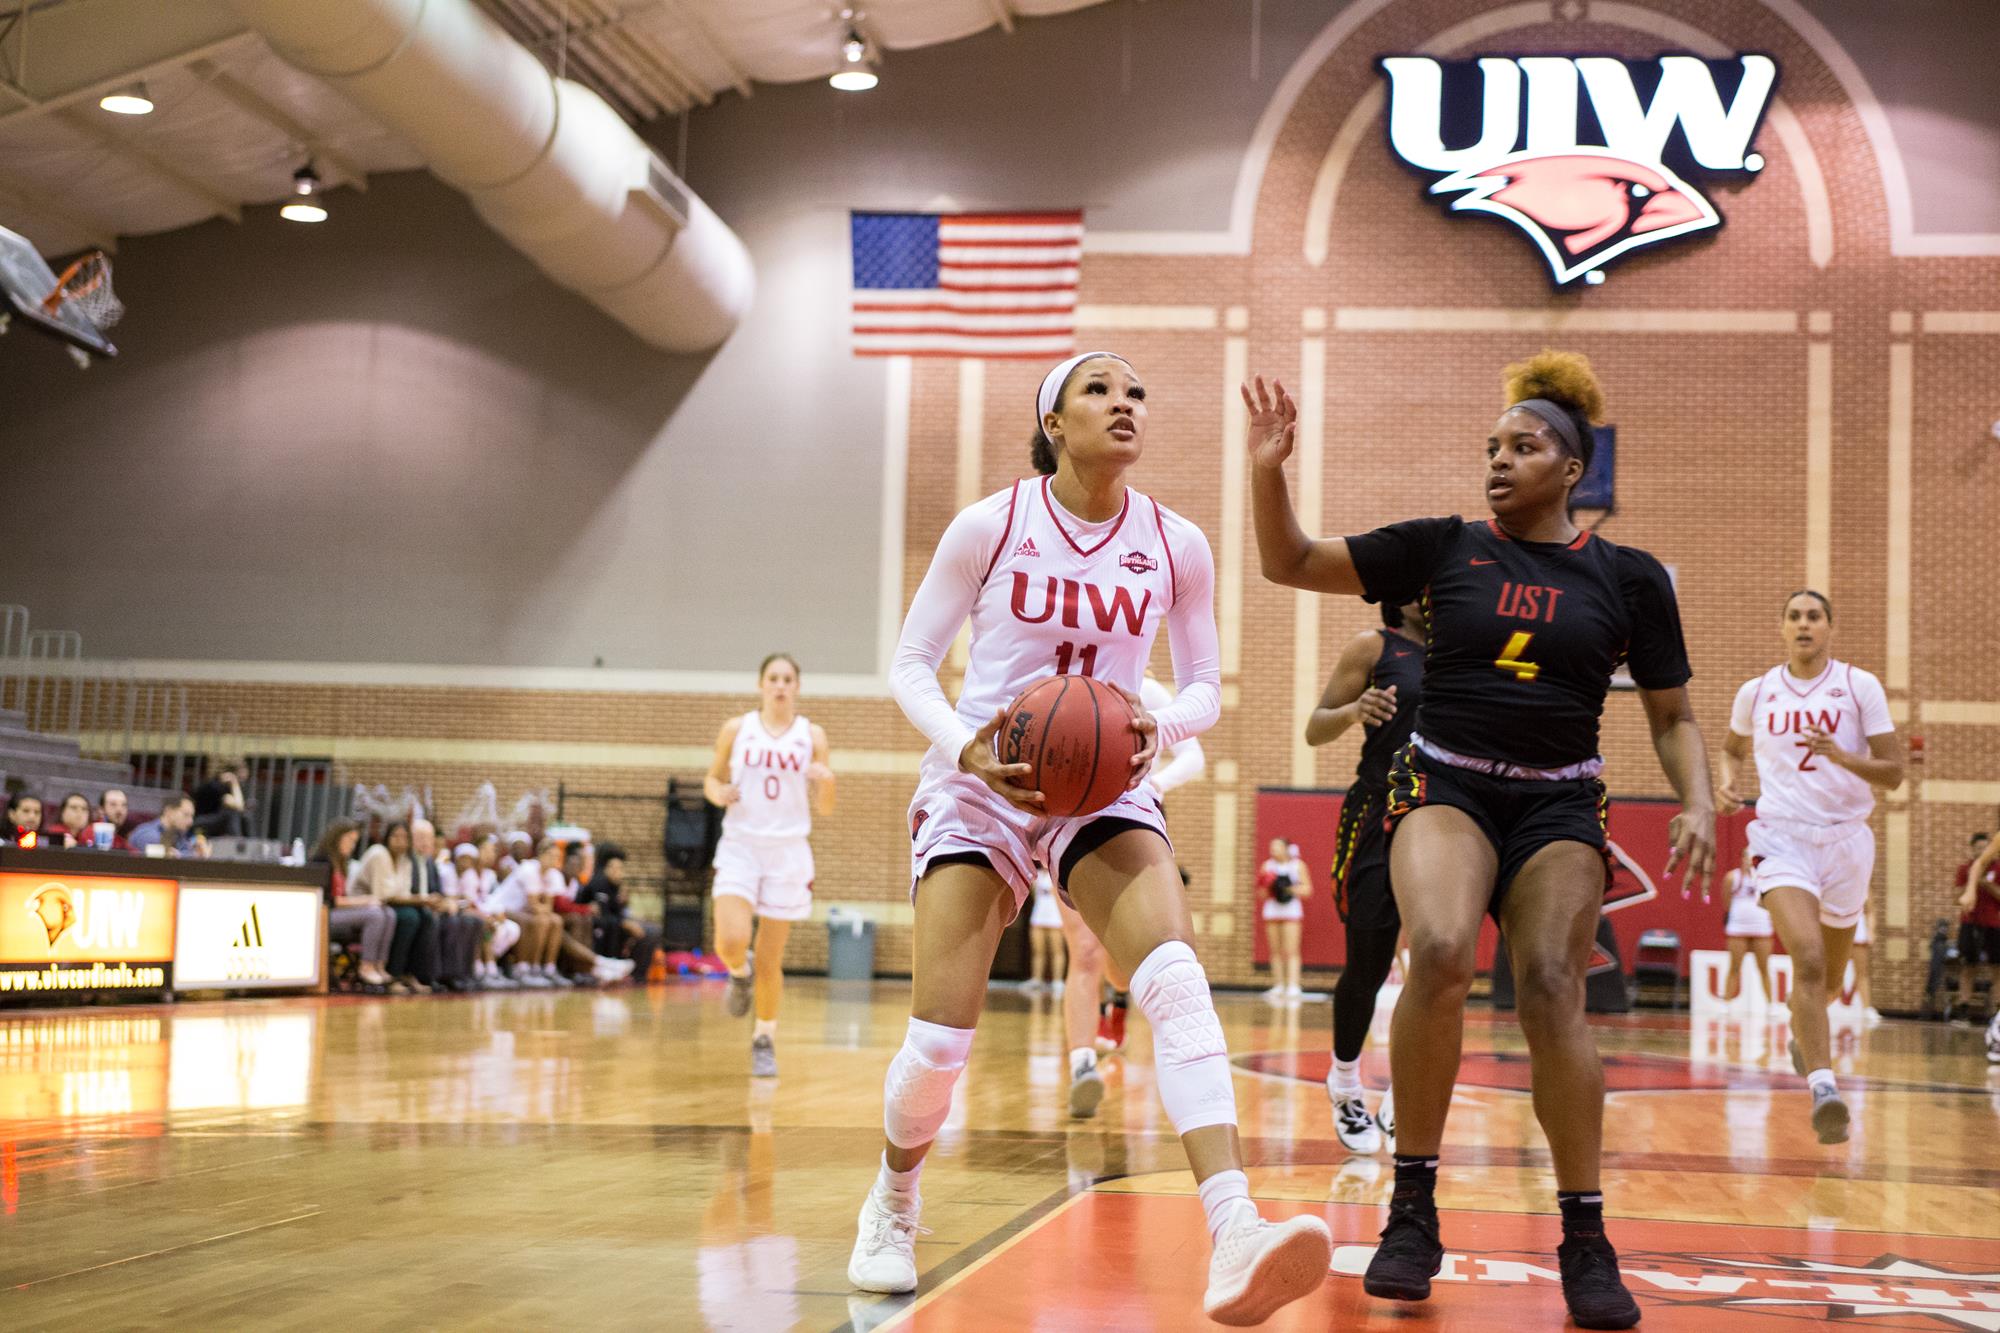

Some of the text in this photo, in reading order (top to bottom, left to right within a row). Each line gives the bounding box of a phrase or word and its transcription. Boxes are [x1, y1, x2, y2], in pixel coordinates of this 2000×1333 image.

[1382, 55, 1776, 172] UIW
[1010, 571, 1151, 637] UIW
[1496, 581, 1564, 623] UST
[1495, 631, 1540, 680] 4
[1768, 709, 1840, 736] UIW
[744, 749, 805, 772] UIW
[1795, 741, 1818, 771] 2
[764, 775, 780, 800] 0
[72, 888, 144, 948] UIW
